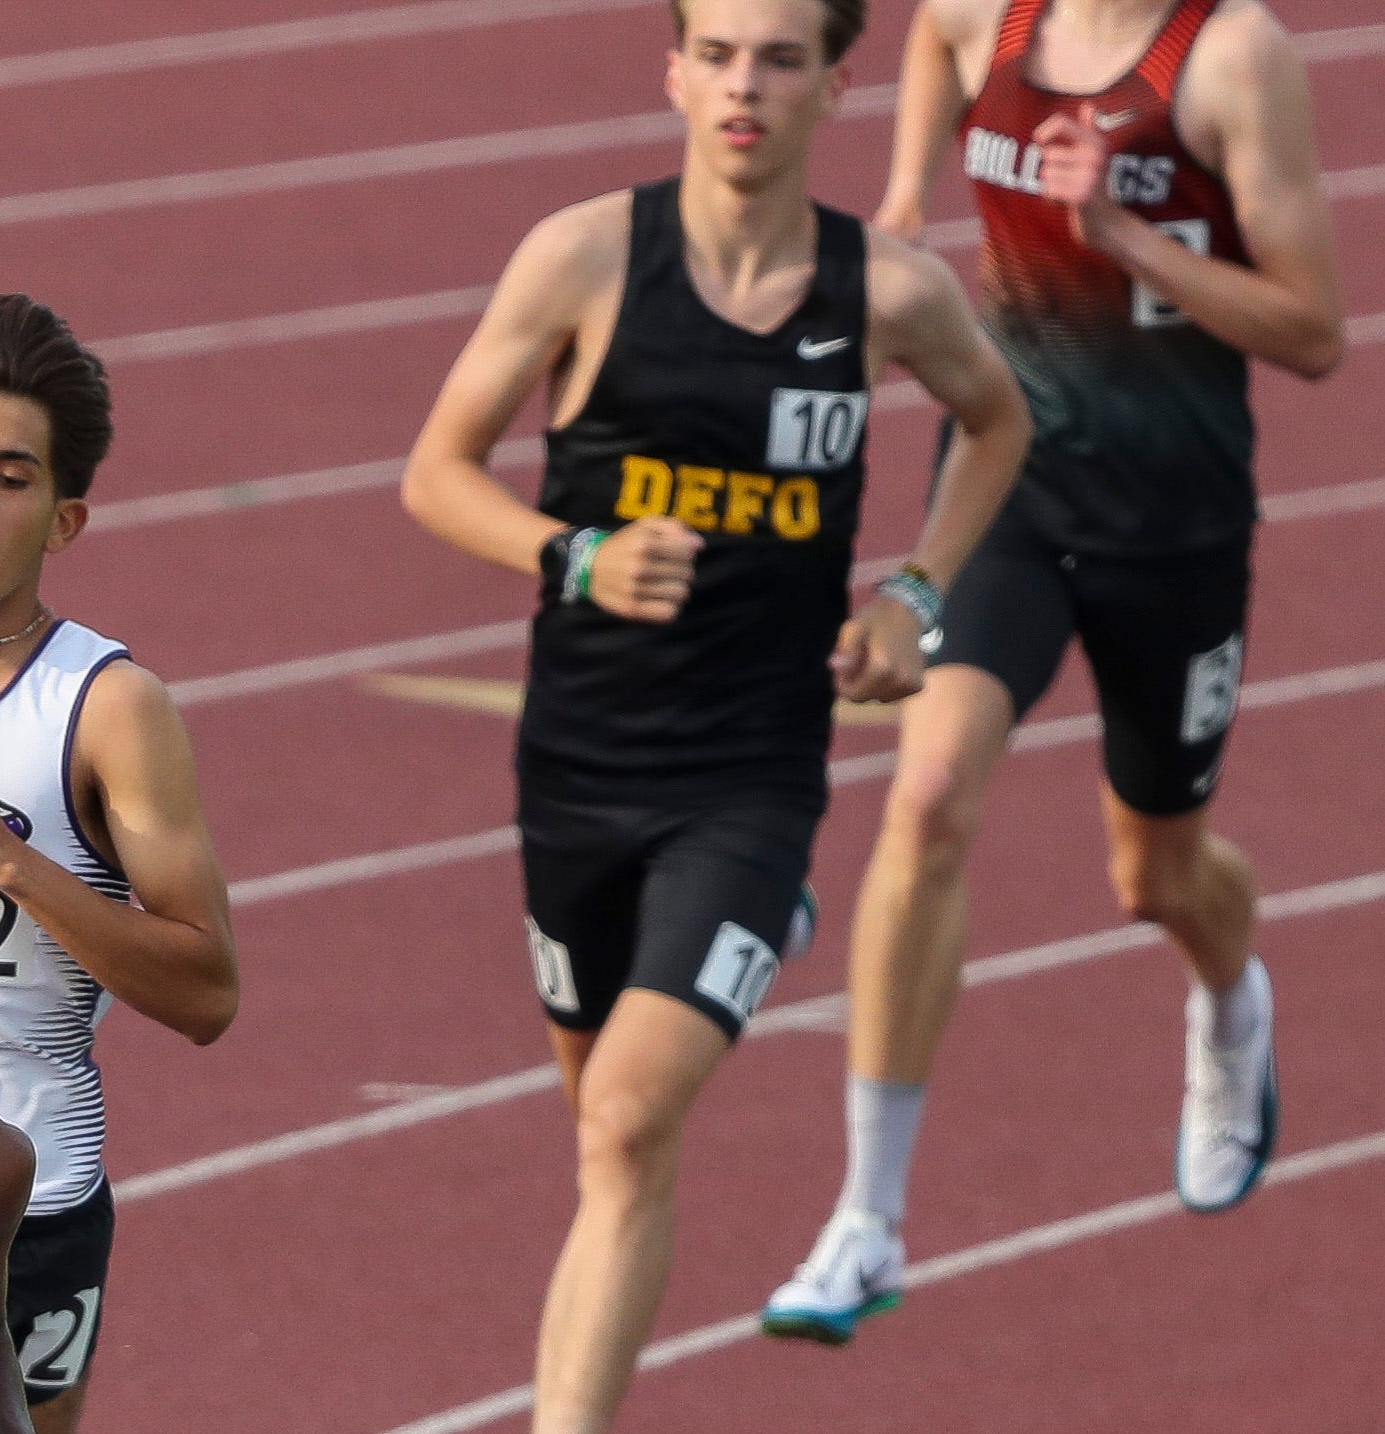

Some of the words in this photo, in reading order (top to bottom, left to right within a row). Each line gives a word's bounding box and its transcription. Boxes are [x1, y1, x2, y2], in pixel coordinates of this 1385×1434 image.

[964, 126, 1176, 206] BULLGS
[793, 398, 857, 464] 10
[614, 454, 822, 541] DEFO
[25, 1294, 87, 1381] 2
